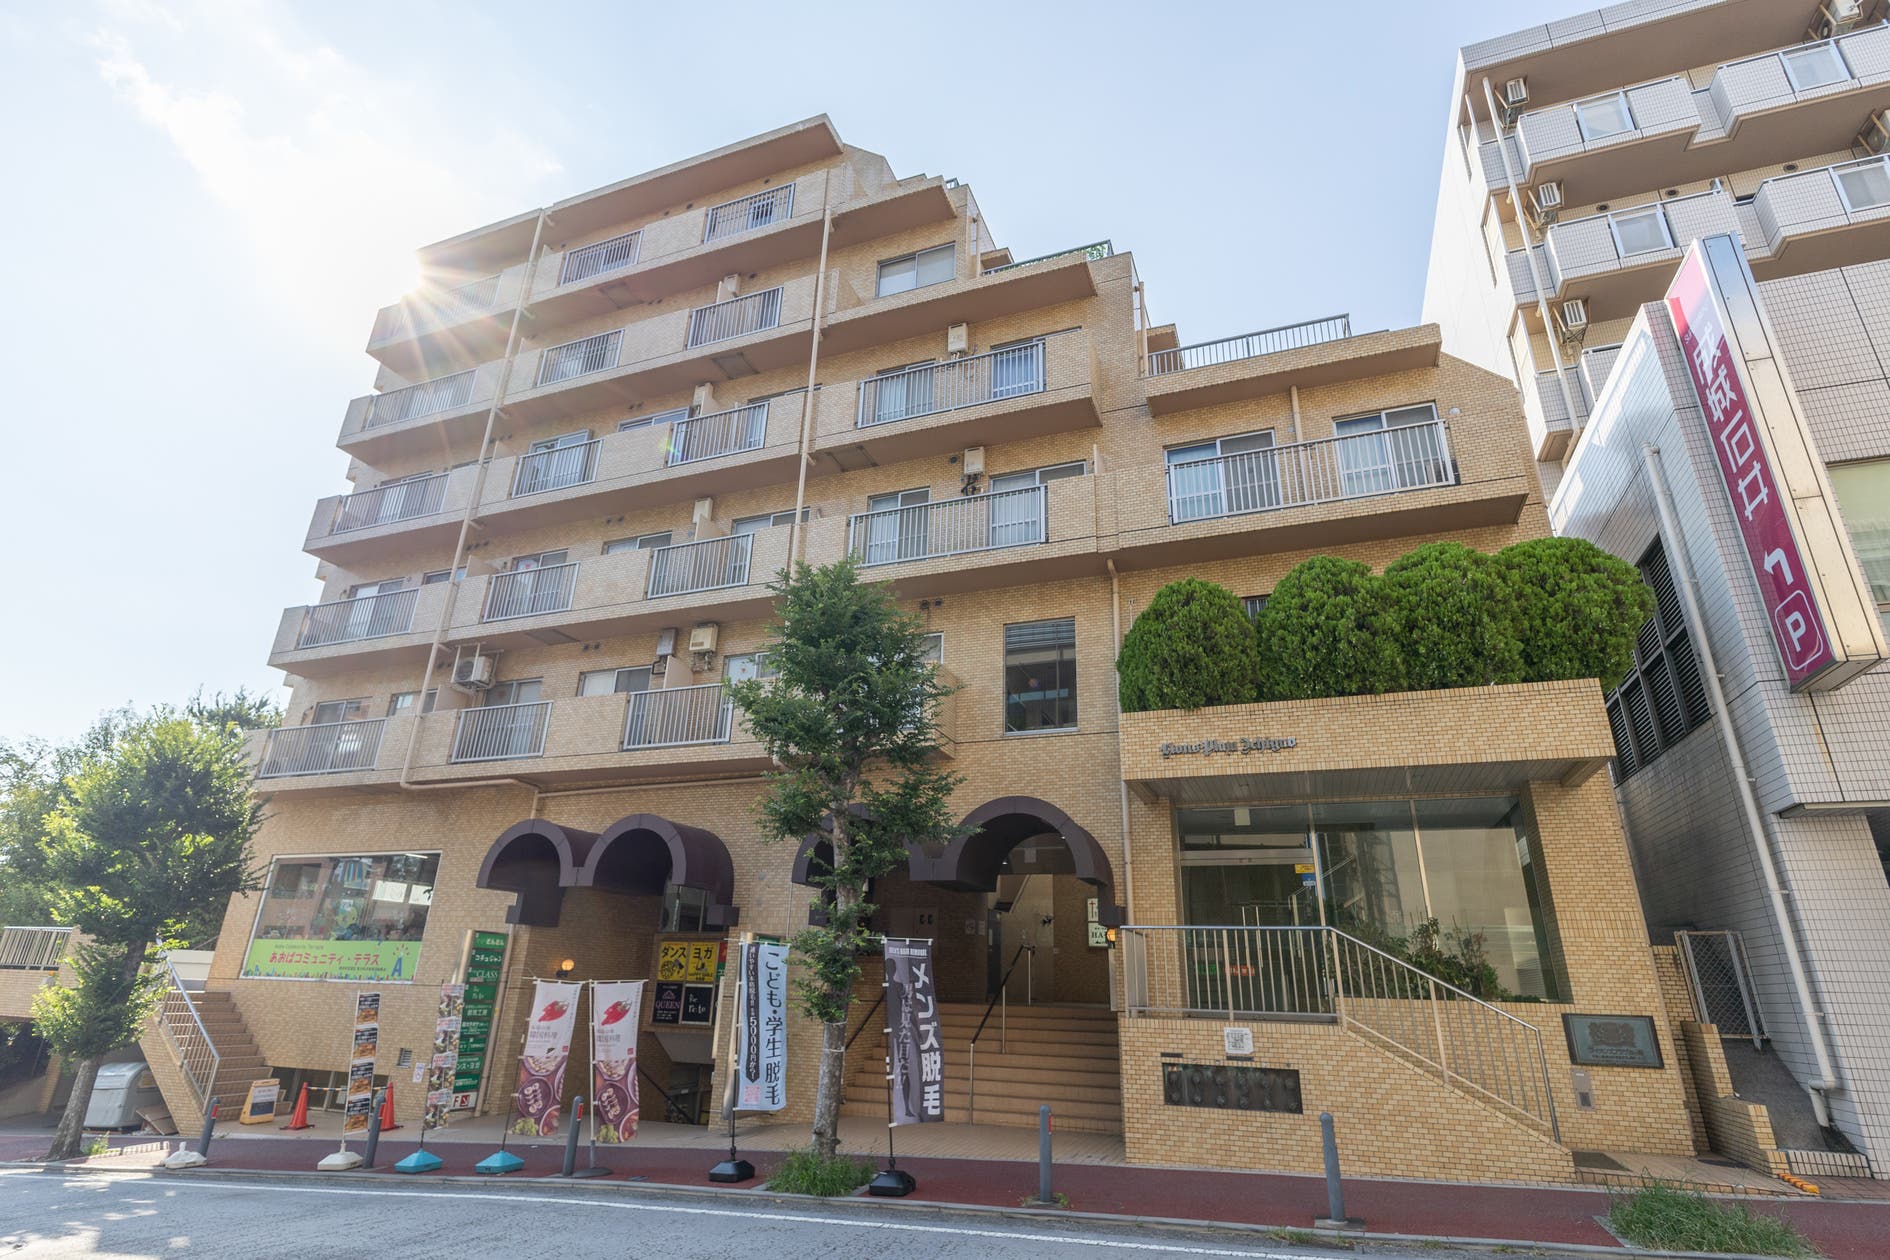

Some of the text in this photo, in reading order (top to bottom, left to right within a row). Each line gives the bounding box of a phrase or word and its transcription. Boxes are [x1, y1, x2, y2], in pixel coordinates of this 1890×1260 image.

[1693, 321, 1769, 521] 成城石井
[1786, 612, 1807, 652] P
[269, 952, 380, 966] あおばコミュニティ・テラス
[662, 945, 687, 958] ダンス
[693, 946, 713, 959] ヨガ
[655, 1000, 681, 1009] QUEEN
[765, 952, 783, 1105] こども・学生脱毛
[912, 963, 942, 1115] メンズ脱毛
